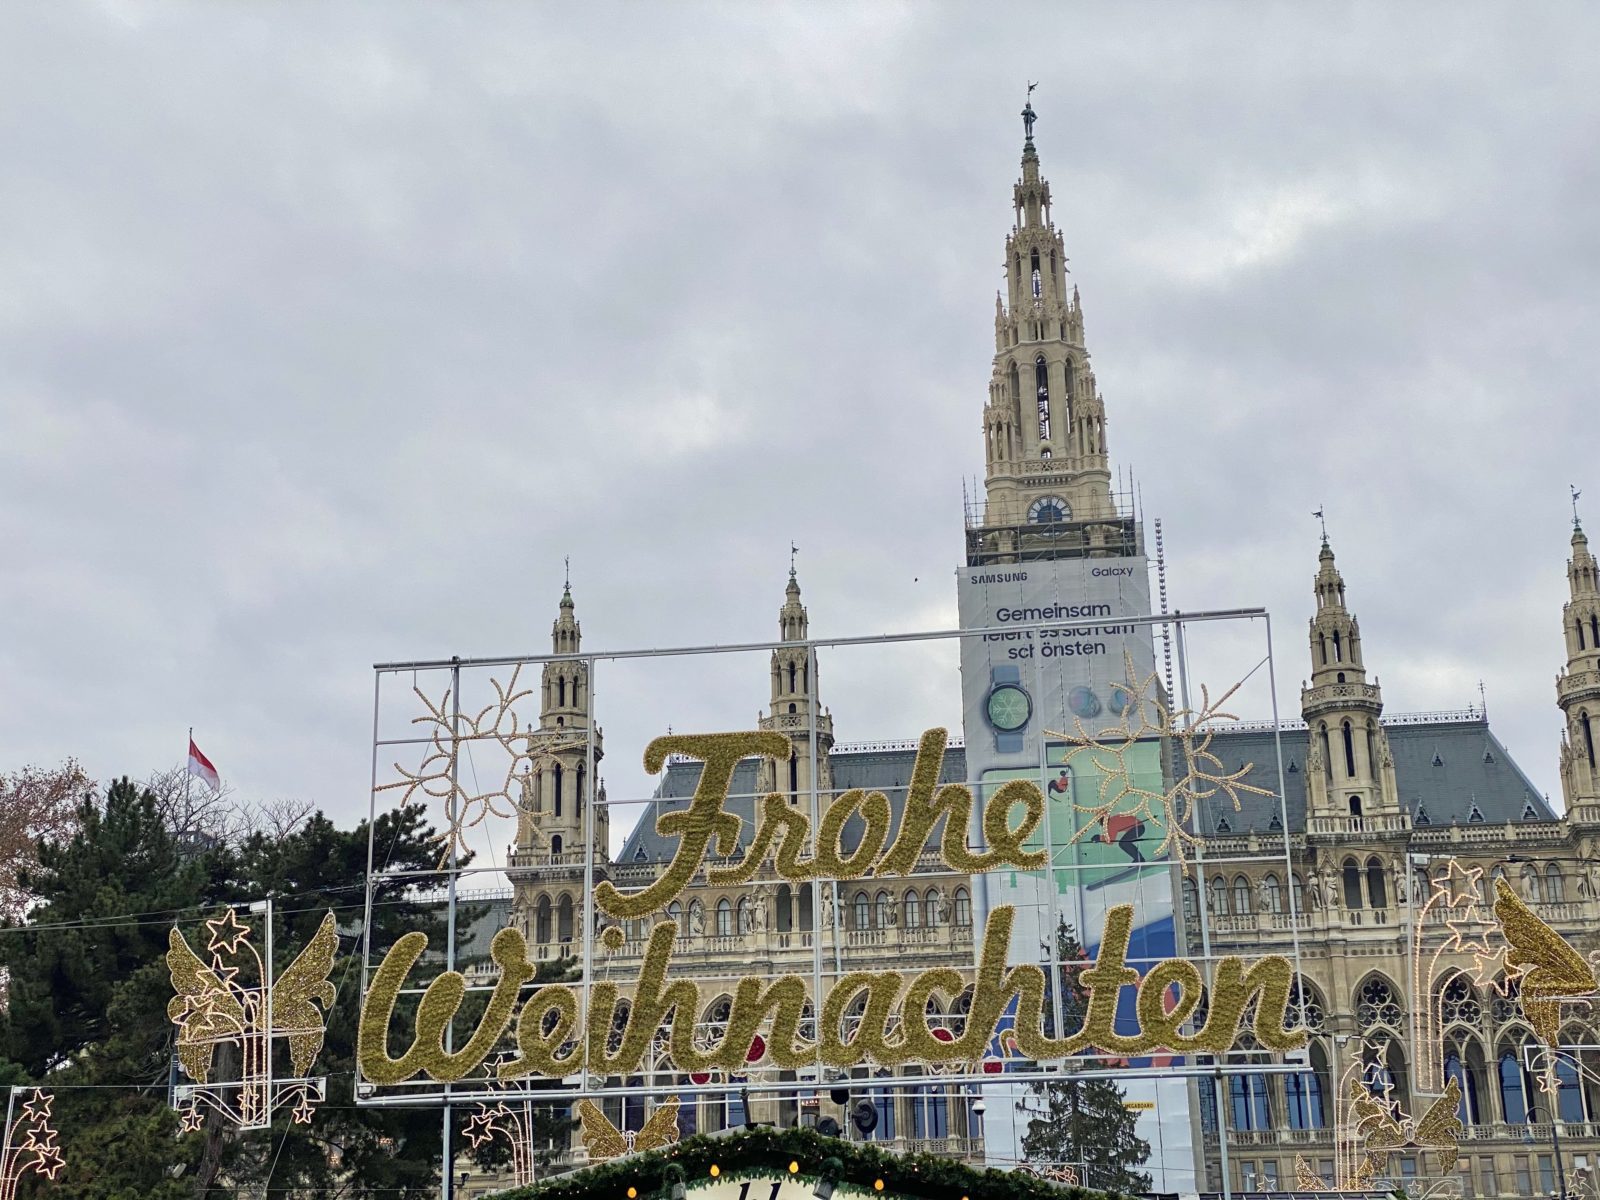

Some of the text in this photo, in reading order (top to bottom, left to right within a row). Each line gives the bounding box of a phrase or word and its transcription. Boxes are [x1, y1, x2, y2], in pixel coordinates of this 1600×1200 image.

[971, 572, 1028, 585] SAMSUNG
[1091, 567, 1133, 577] Galaxy
[996, 602, 1111, 622] Gemeinsam
[594, 727, 1048, 919] Frohe
[357, 904, 1307, 1086] Weihnachten
